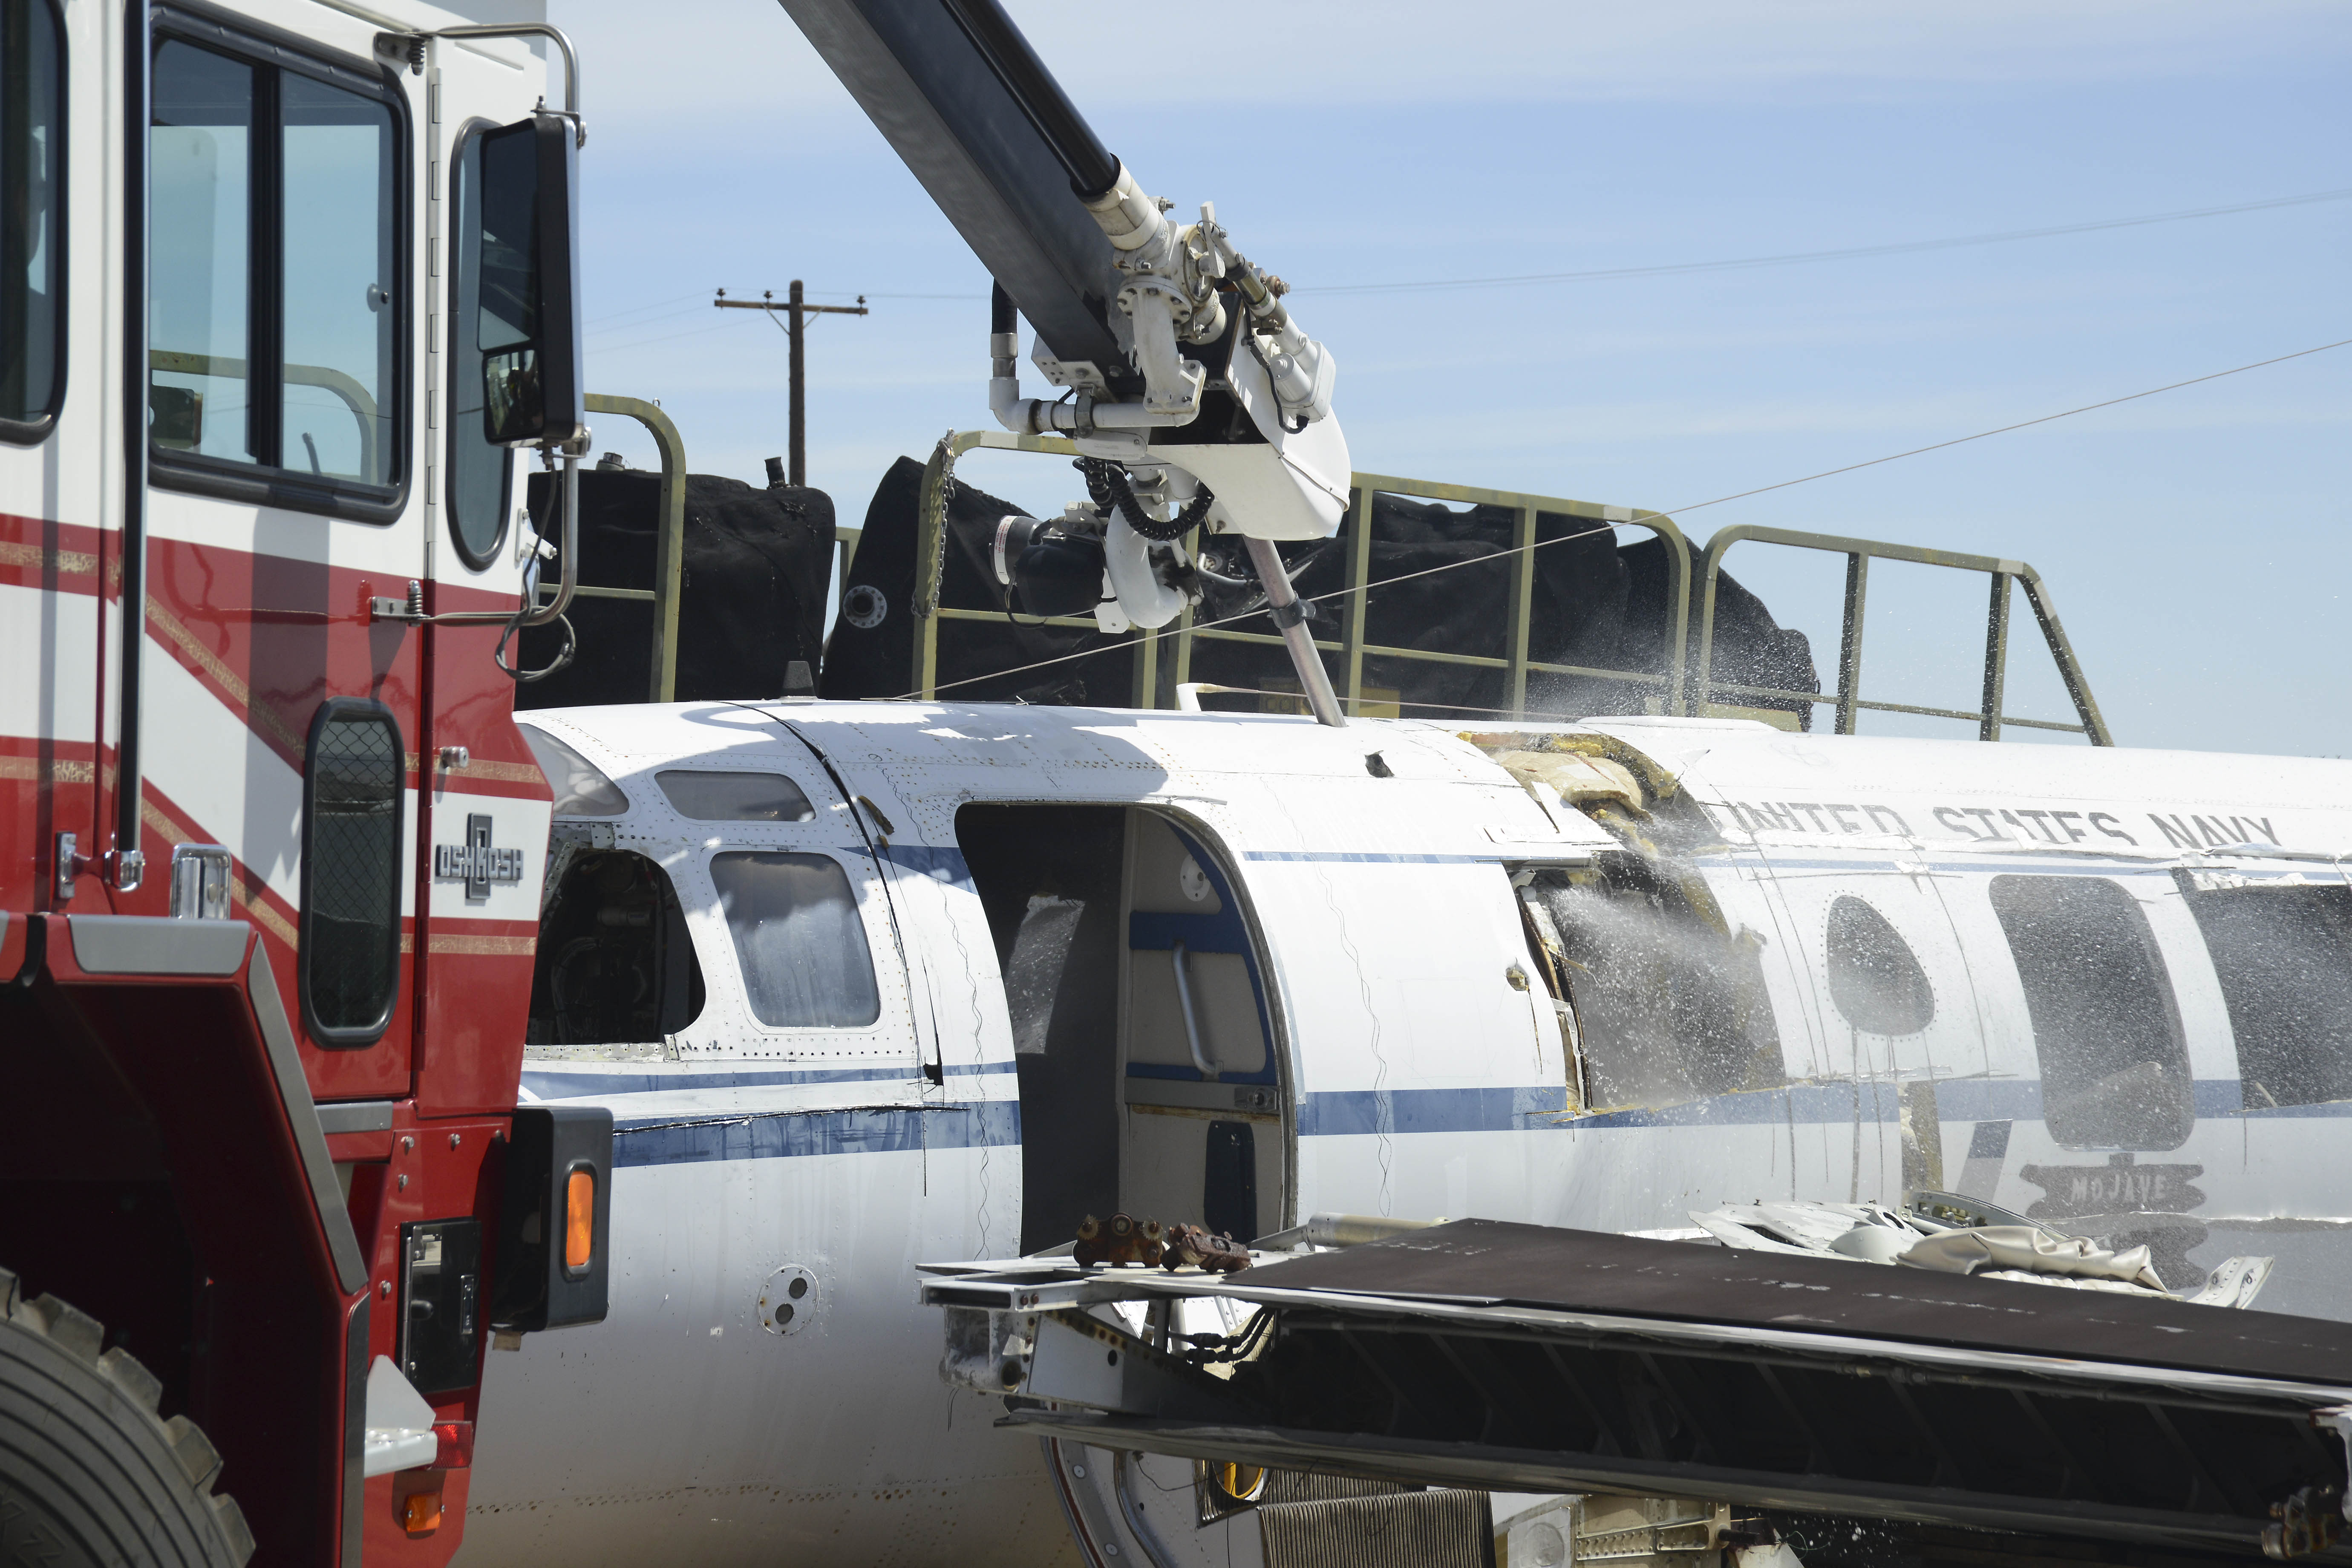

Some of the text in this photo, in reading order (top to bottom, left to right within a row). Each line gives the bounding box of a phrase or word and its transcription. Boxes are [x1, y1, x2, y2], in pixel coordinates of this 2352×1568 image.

[2147, 813, 2282, 850] NAVY
[436, 844, 524, 881] OSHKOSH
[2071, 1174, 2166, 1202] MOJAVE
